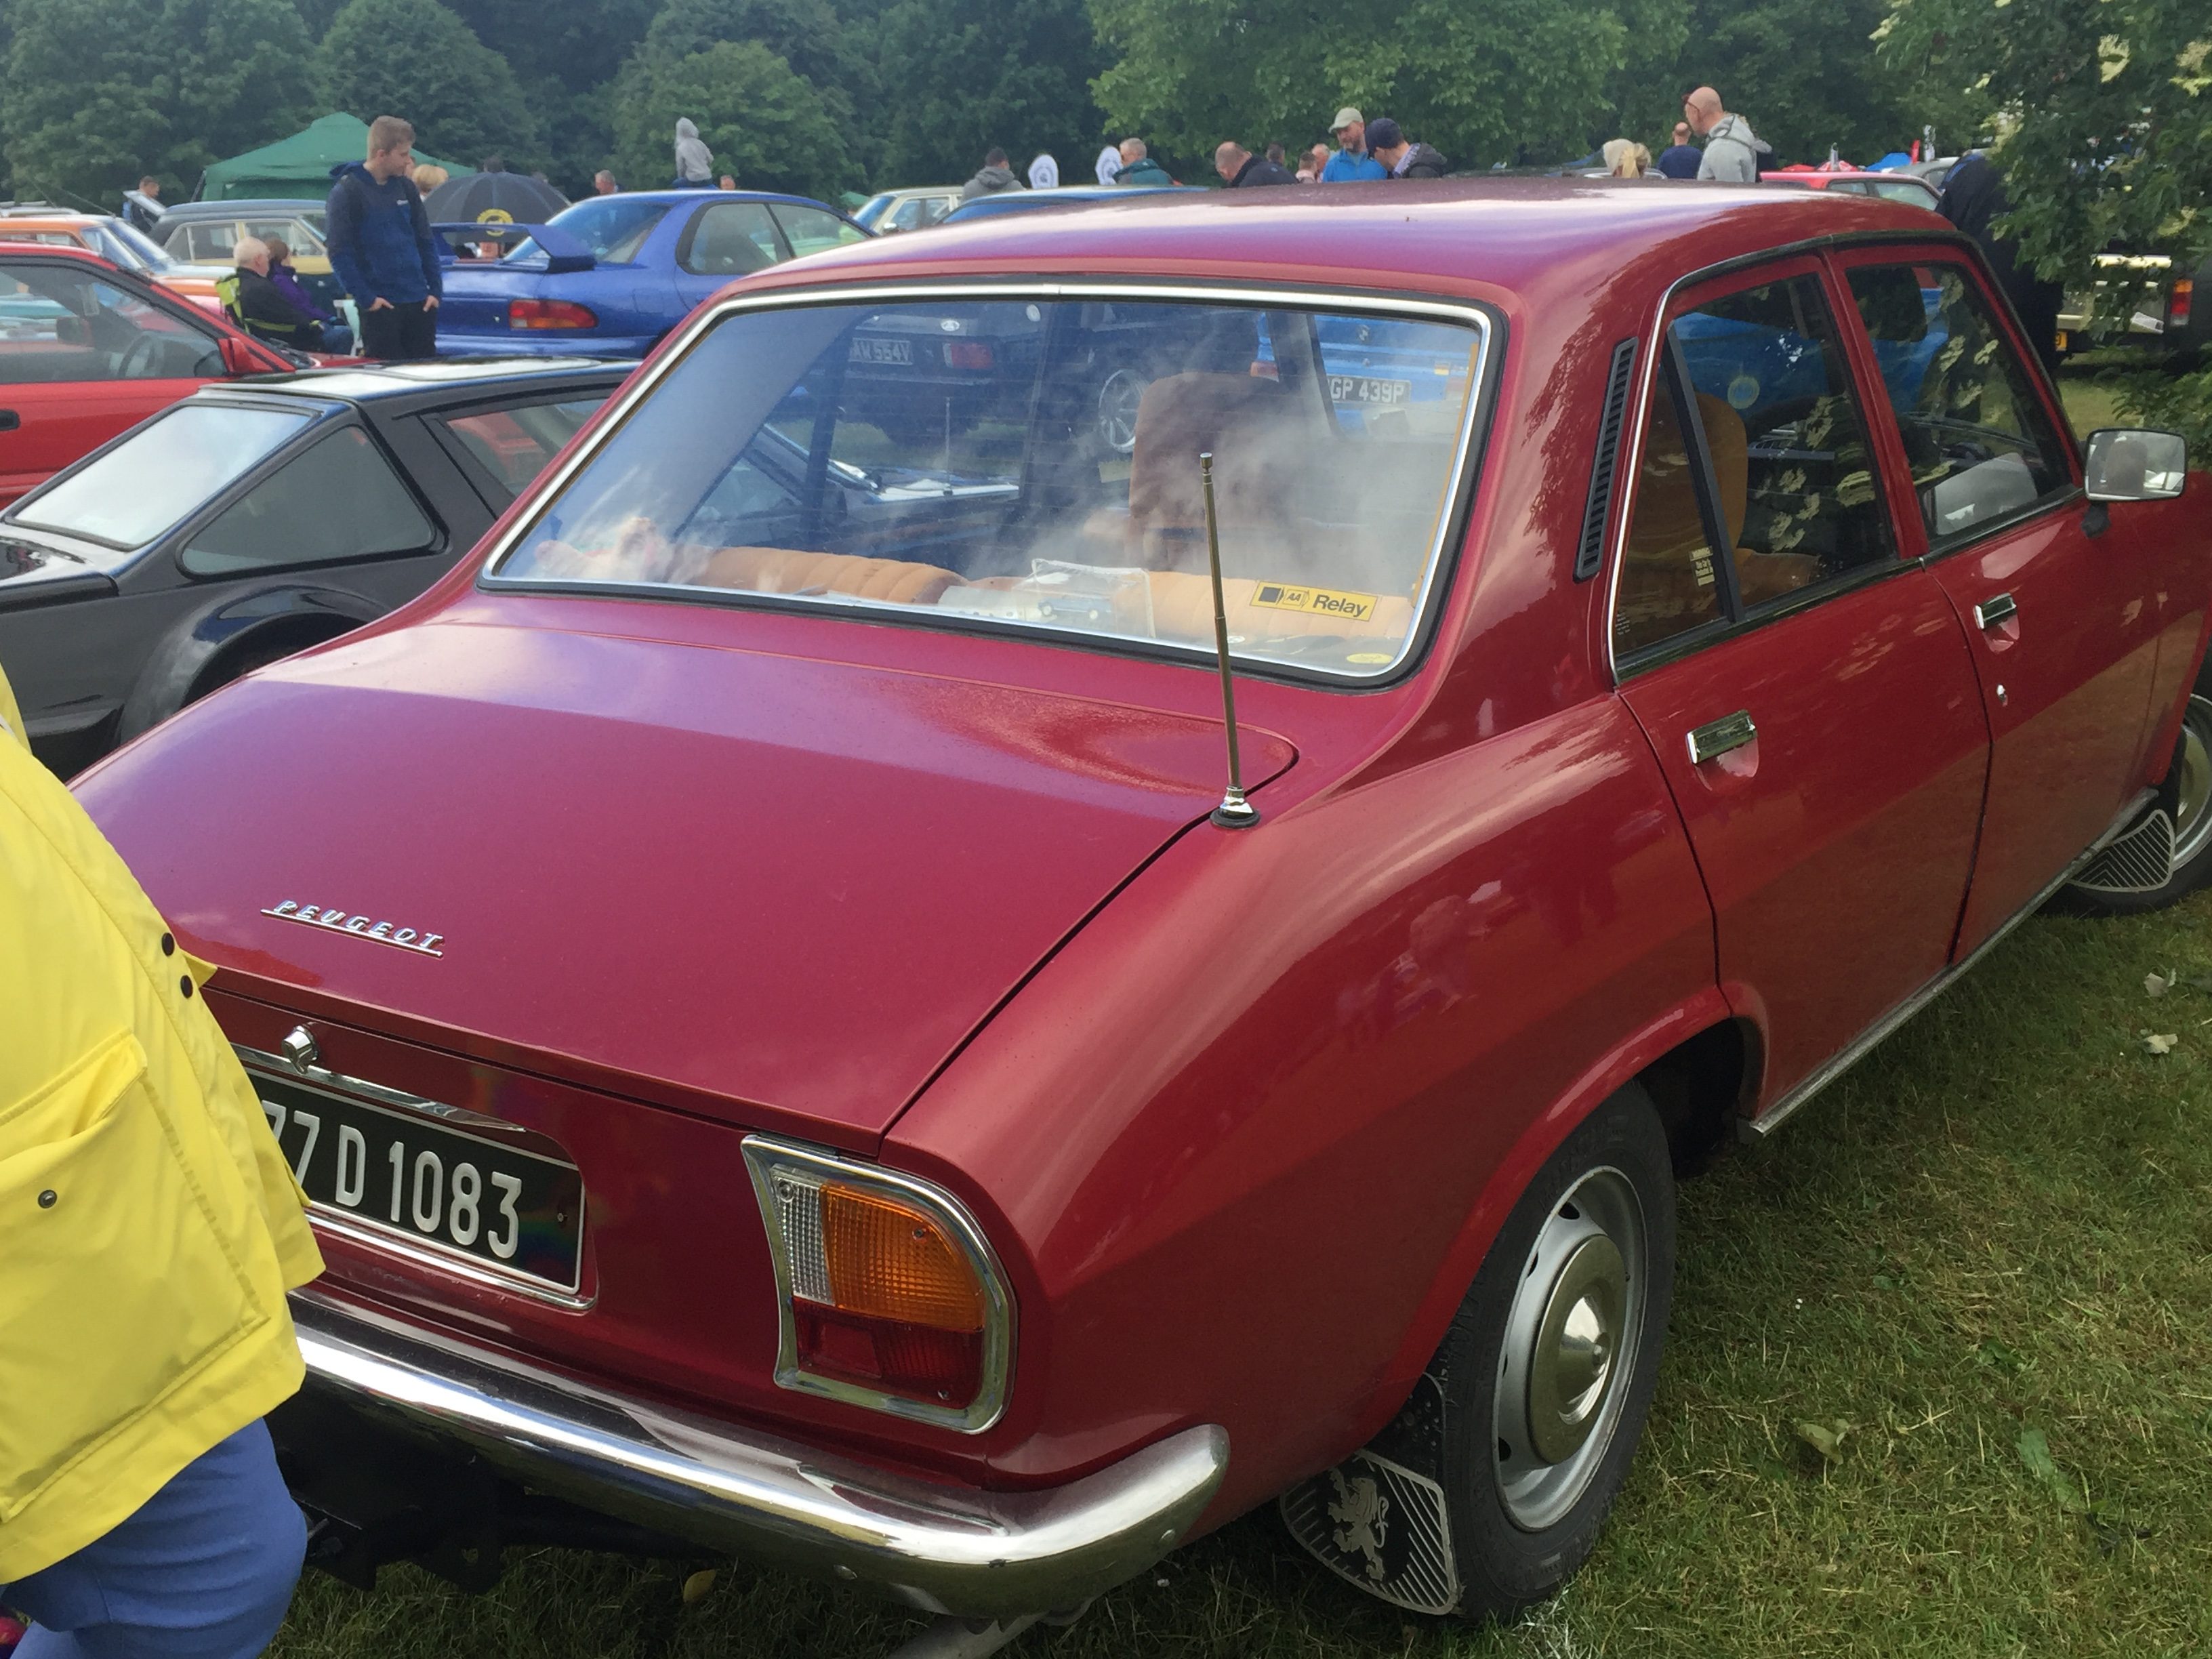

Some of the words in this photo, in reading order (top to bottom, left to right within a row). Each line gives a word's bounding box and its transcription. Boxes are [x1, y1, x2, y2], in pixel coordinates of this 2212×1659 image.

[1328, 377, 1353, 401] GP
[1358, 380, 1405, 404] 439P
[1312, 594, 1368, 617] Relay
[273, 899, 445, 948] PEUGEOT
[335, 1124, 367, 1208] D
[388, 1141, 523, 1259] 1083
